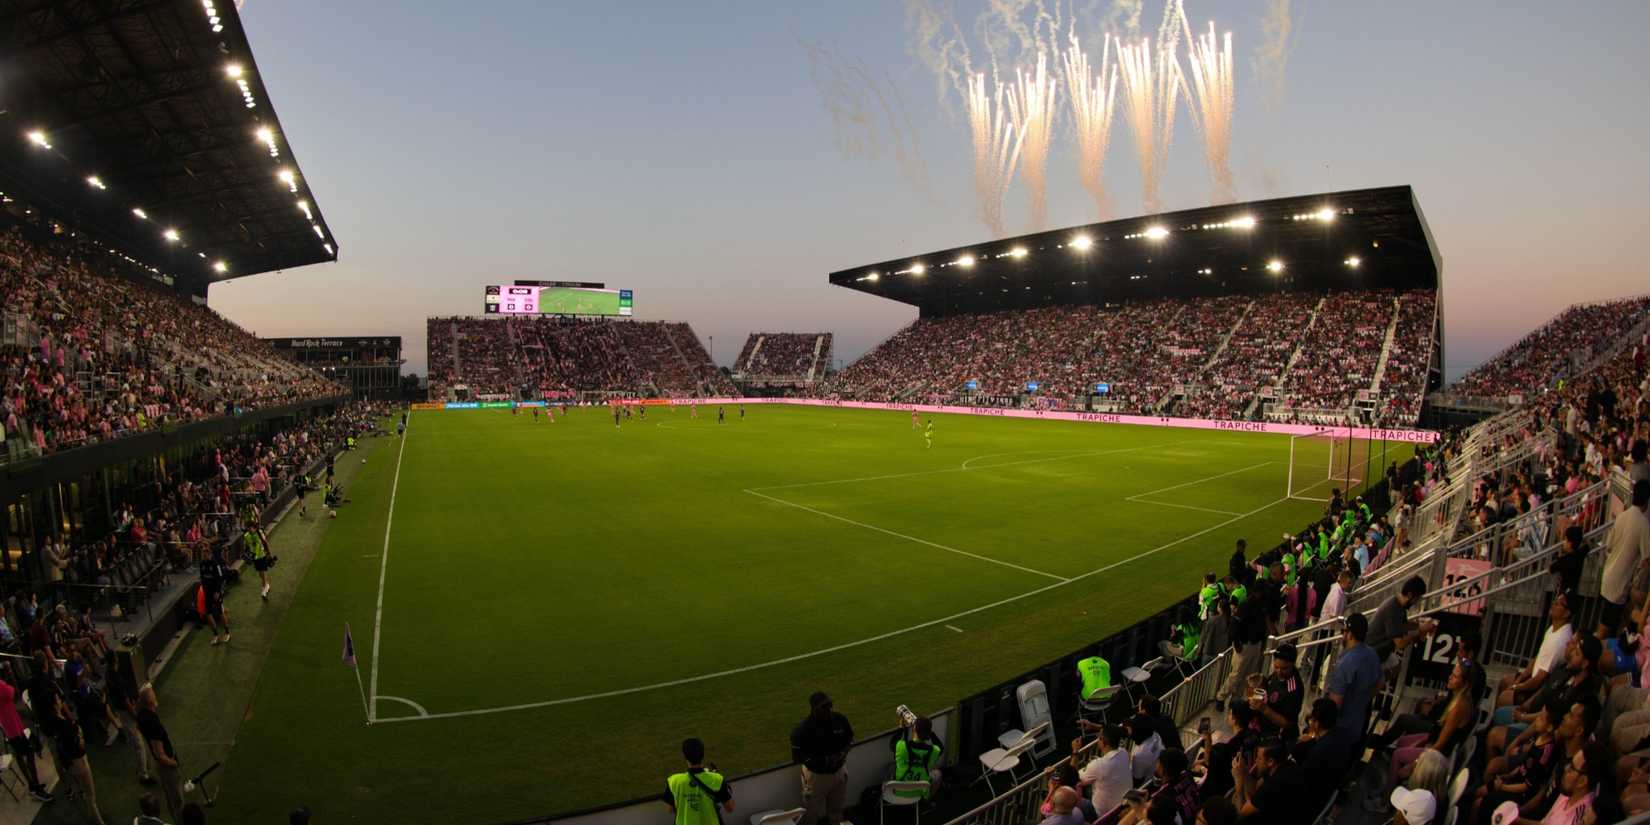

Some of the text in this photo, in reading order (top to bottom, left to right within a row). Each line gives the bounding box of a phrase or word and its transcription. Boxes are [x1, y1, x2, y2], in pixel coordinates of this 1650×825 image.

[970, 407, 1004, 416] TRAPICHE
[1076, 413, 1121, 423] TRAPICHE
[1213, 420, 1267, 432] TRAPICHE
[1374, 430, 1431, 442] TRAPICHE
